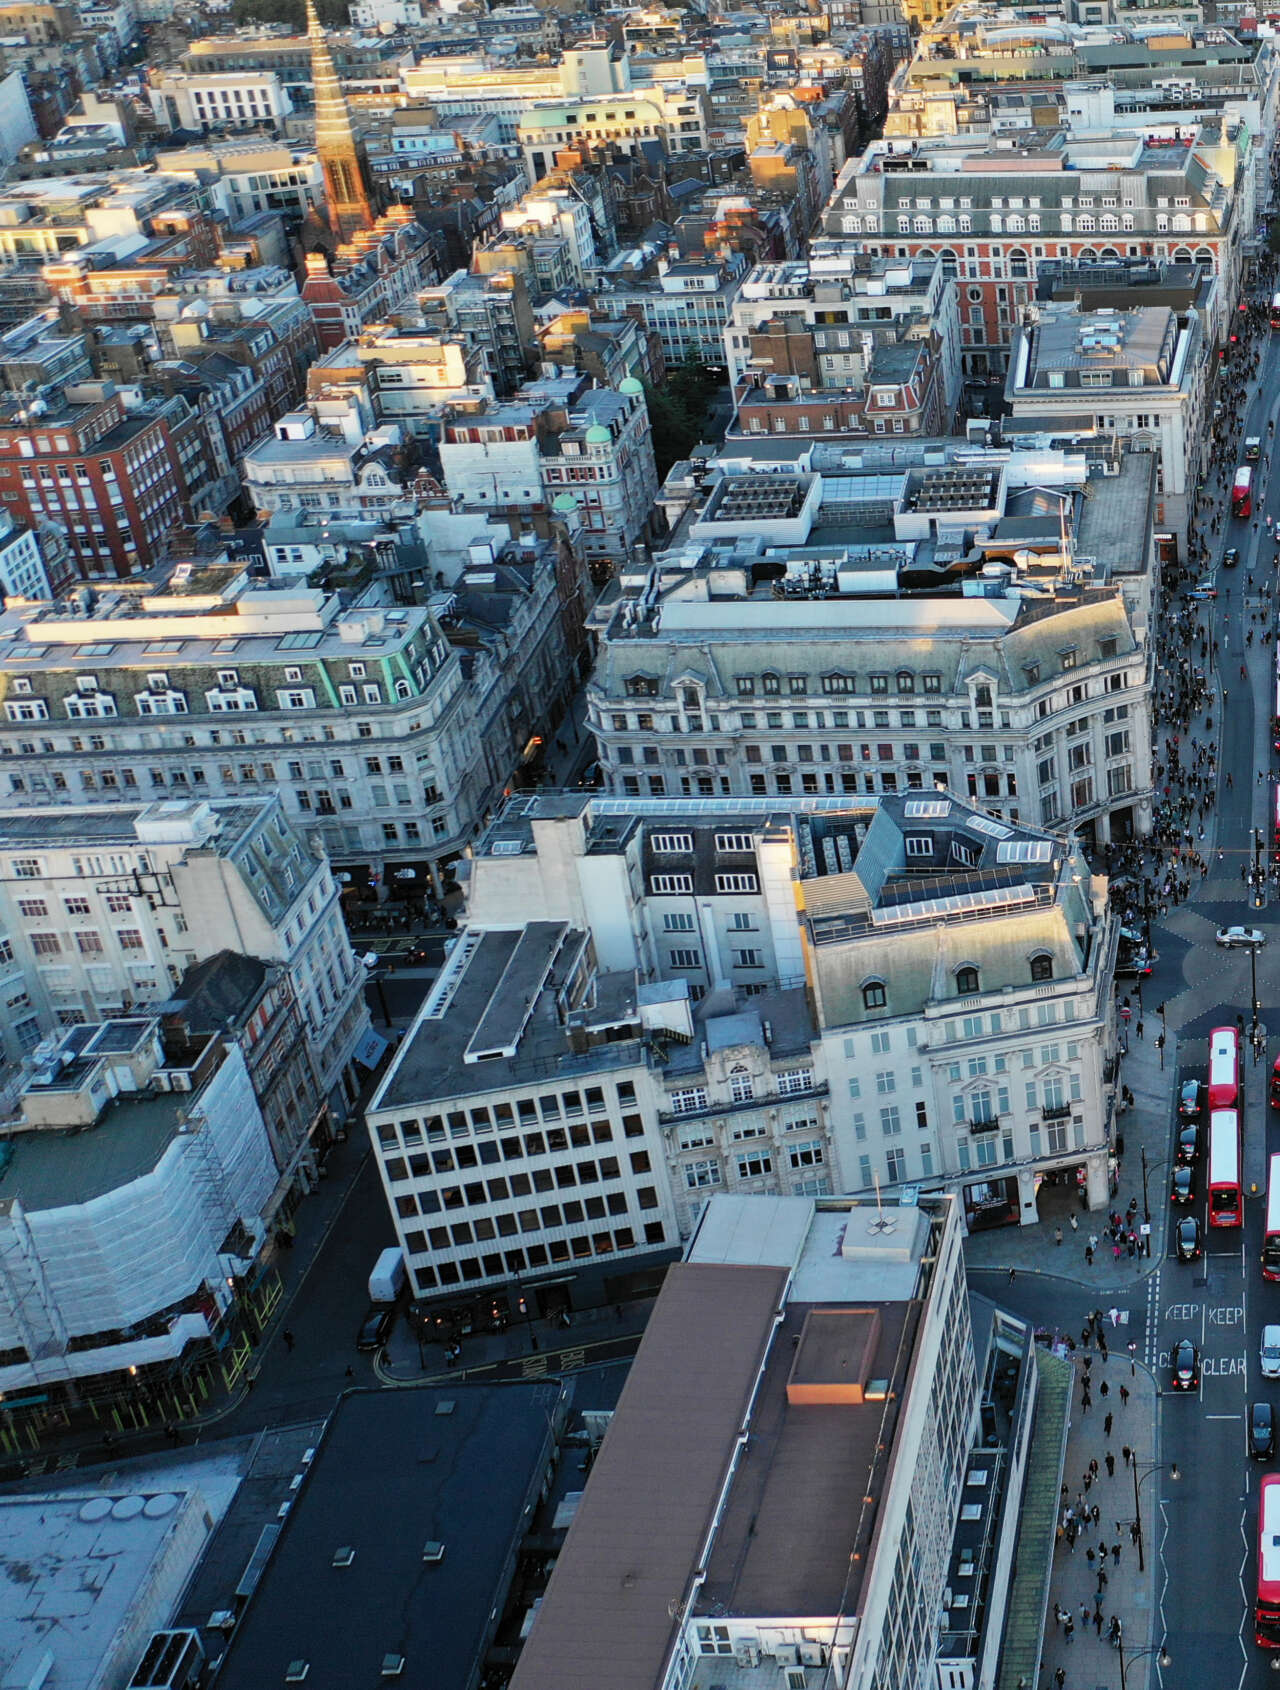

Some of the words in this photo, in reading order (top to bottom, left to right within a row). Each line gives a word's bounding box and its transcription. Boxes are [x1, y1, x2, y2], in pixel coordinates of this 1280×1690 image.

[1165, 1304, 1199, 1320] KEEP
[1208, 1308, 1243, 1325] KEEP
[1203, 1358, 1246, 1376] CLEAR
